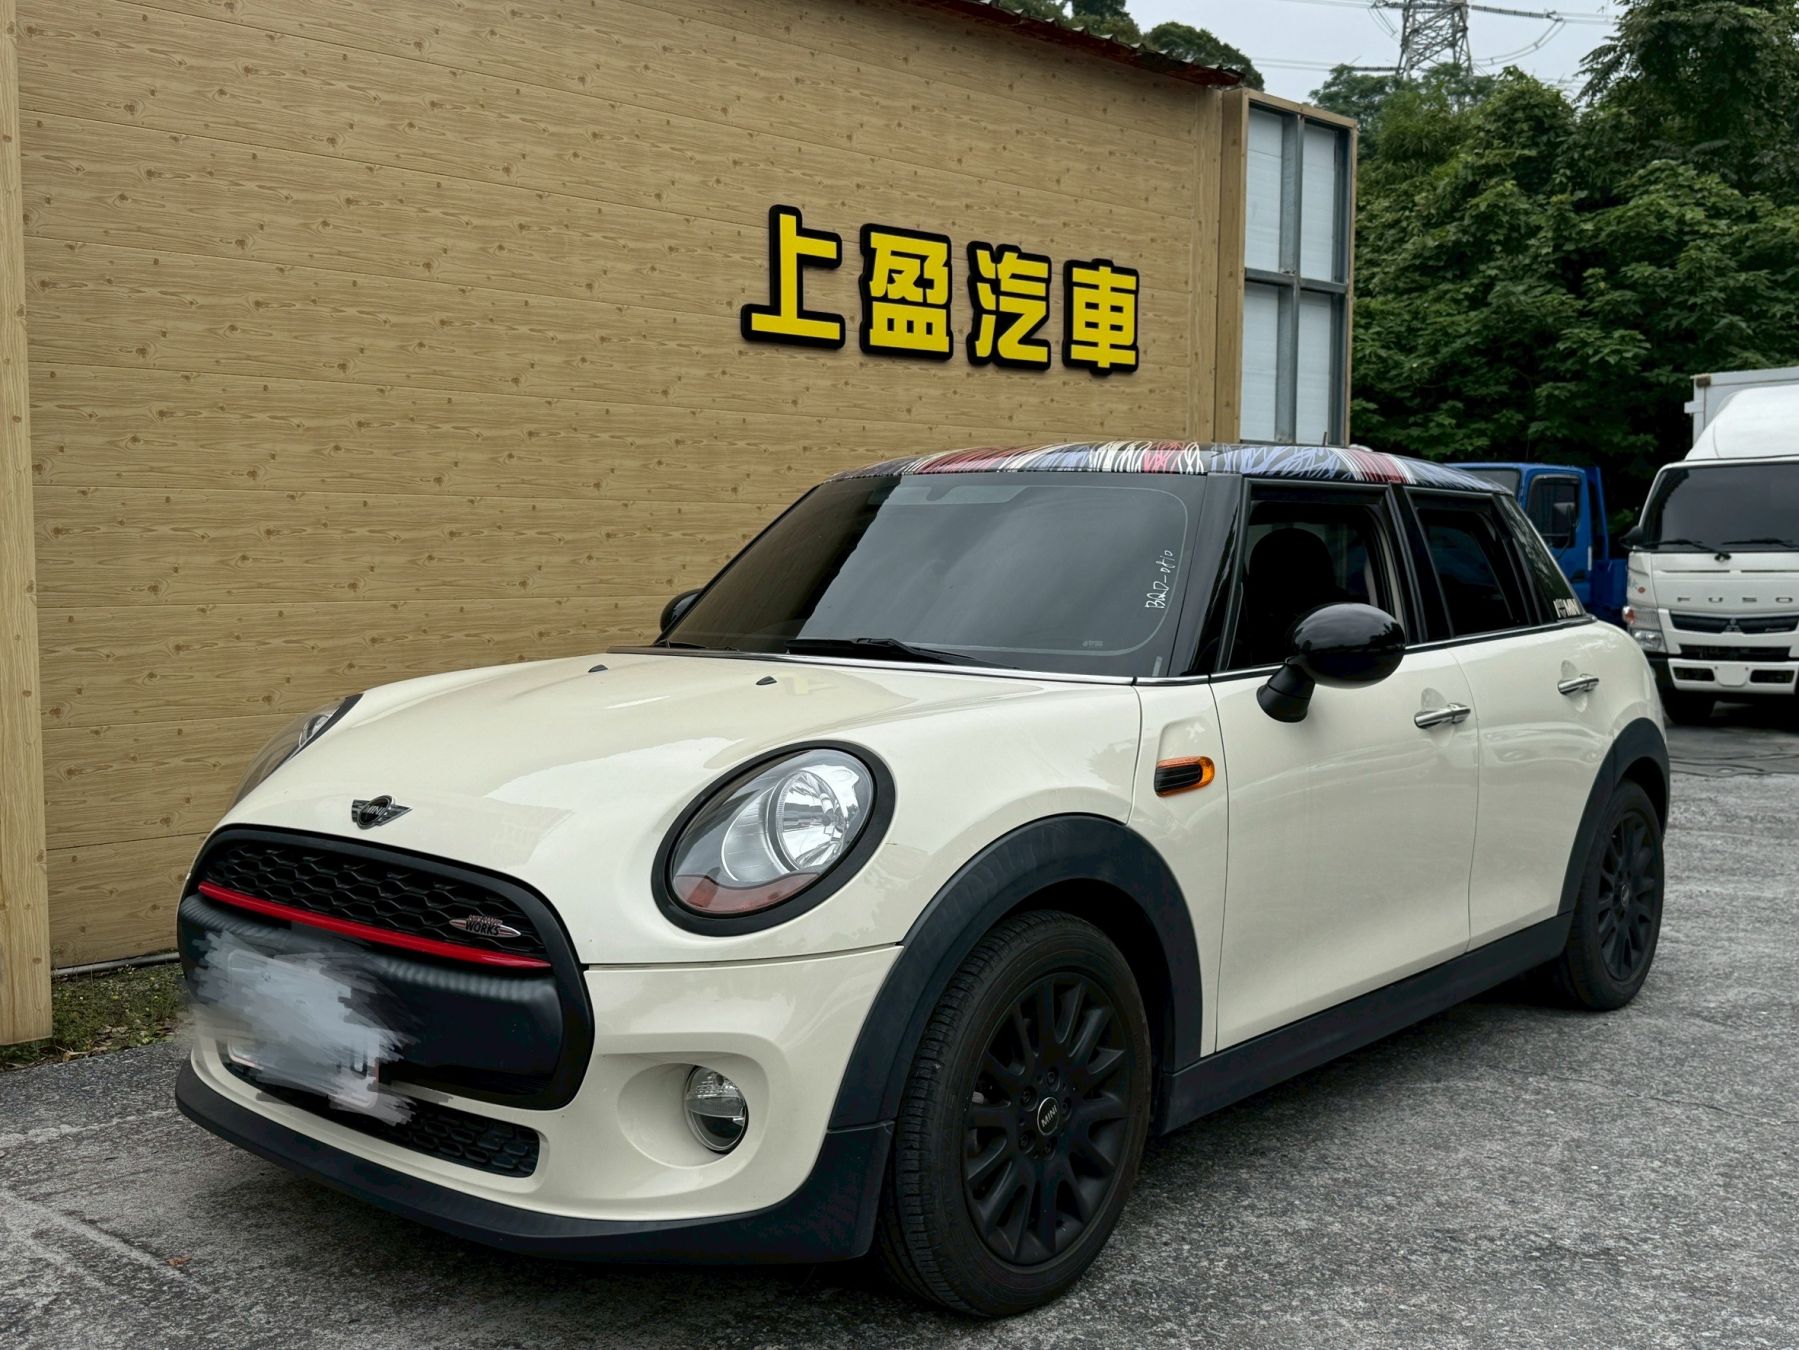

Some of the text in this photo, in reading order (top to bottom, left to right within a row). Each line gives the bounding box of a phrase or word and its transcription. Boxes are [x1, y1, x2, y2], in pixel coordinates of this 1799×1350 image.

[742, 206, 1139, 374] 上盈汽車
[465, 920, 500, 936] WORKS
[1040, 1105, 1058, 1128] MINI
